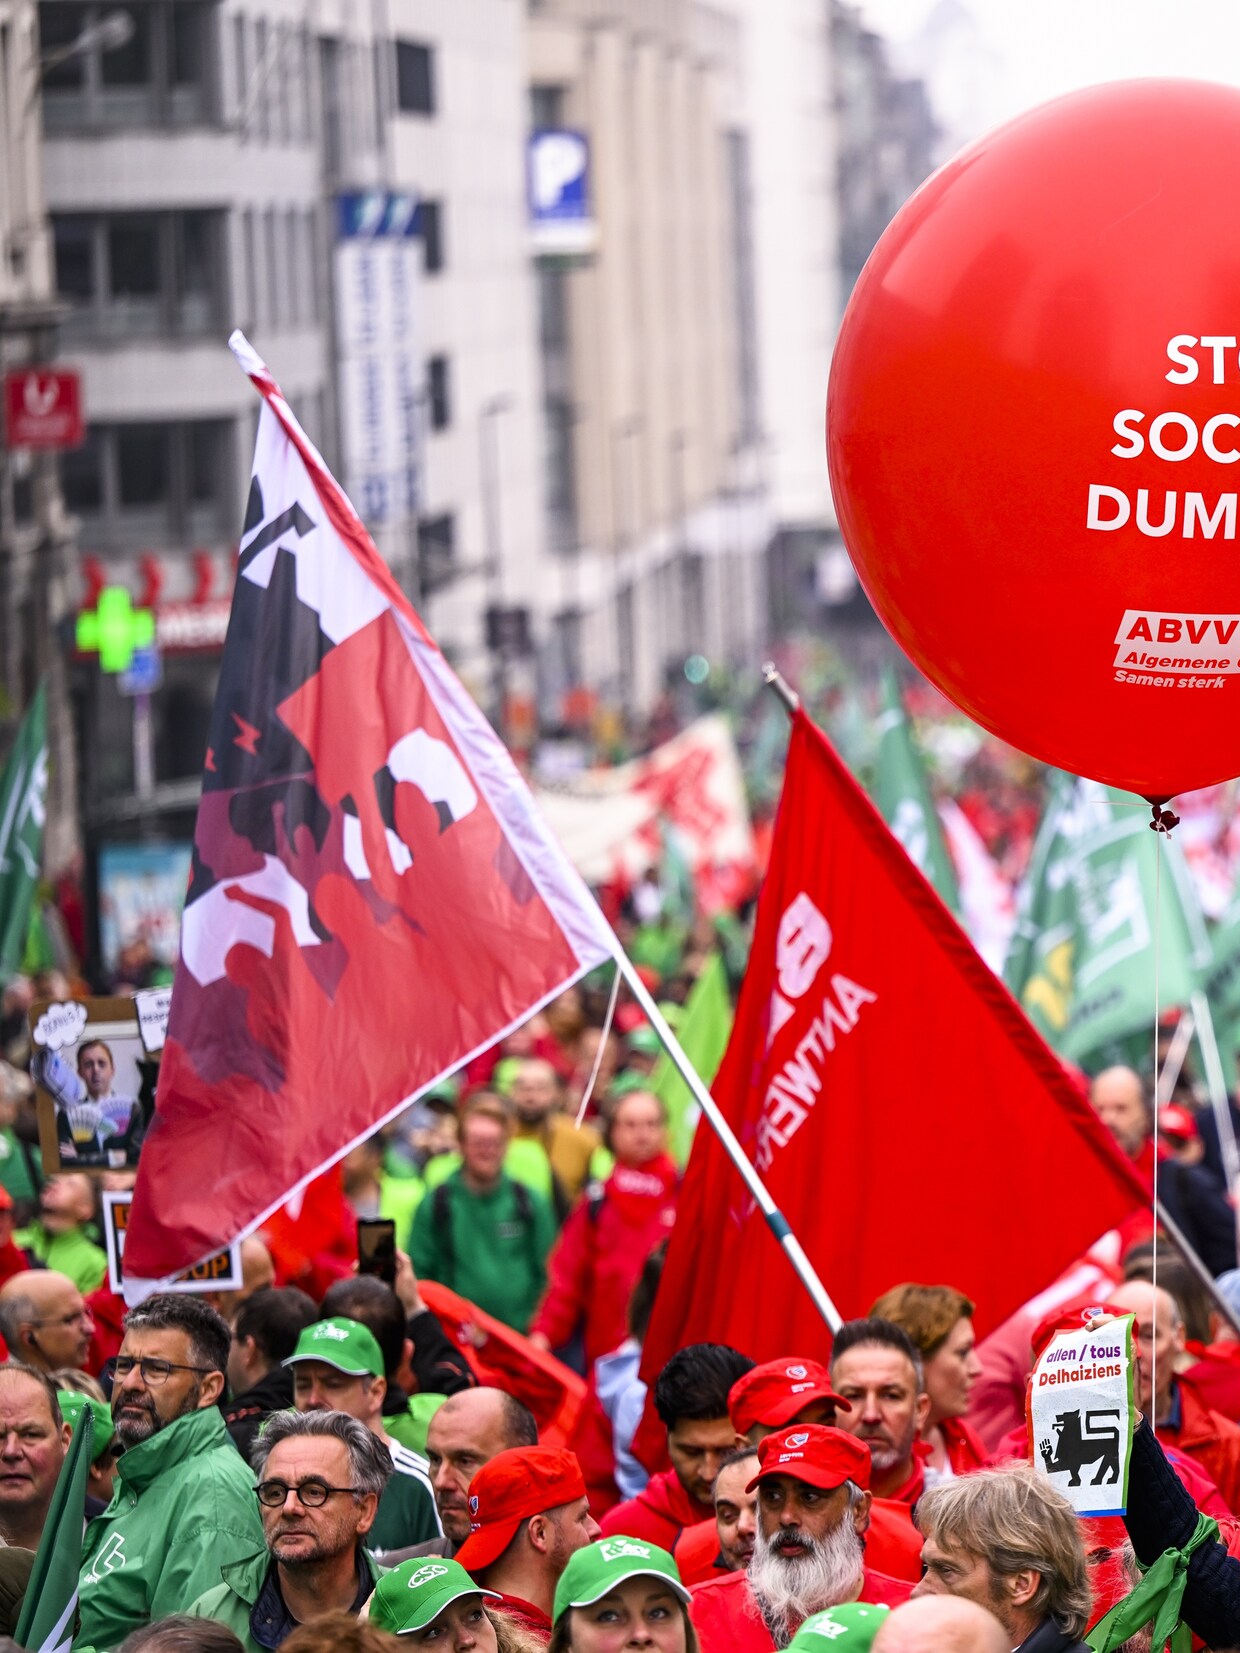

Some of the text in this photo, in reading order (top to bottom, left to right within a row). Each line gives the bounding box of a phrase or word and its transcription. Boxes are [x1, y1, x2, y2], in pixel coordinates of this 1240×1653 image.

[533, 136, 587, 208] P
[1126, 617, 1239, 645] ABVV
[1123, 651, 1230, 670] Algemene
[1113, 670, 1226, 689] Samen sterk
[1047, 1348, 1076, 1363] allen
[1090, 1345, 1121, 1359] tous
[1039, 1363, 1121, 1387] Delhaiziens
[411, 1565, 447, 1587] CSC
